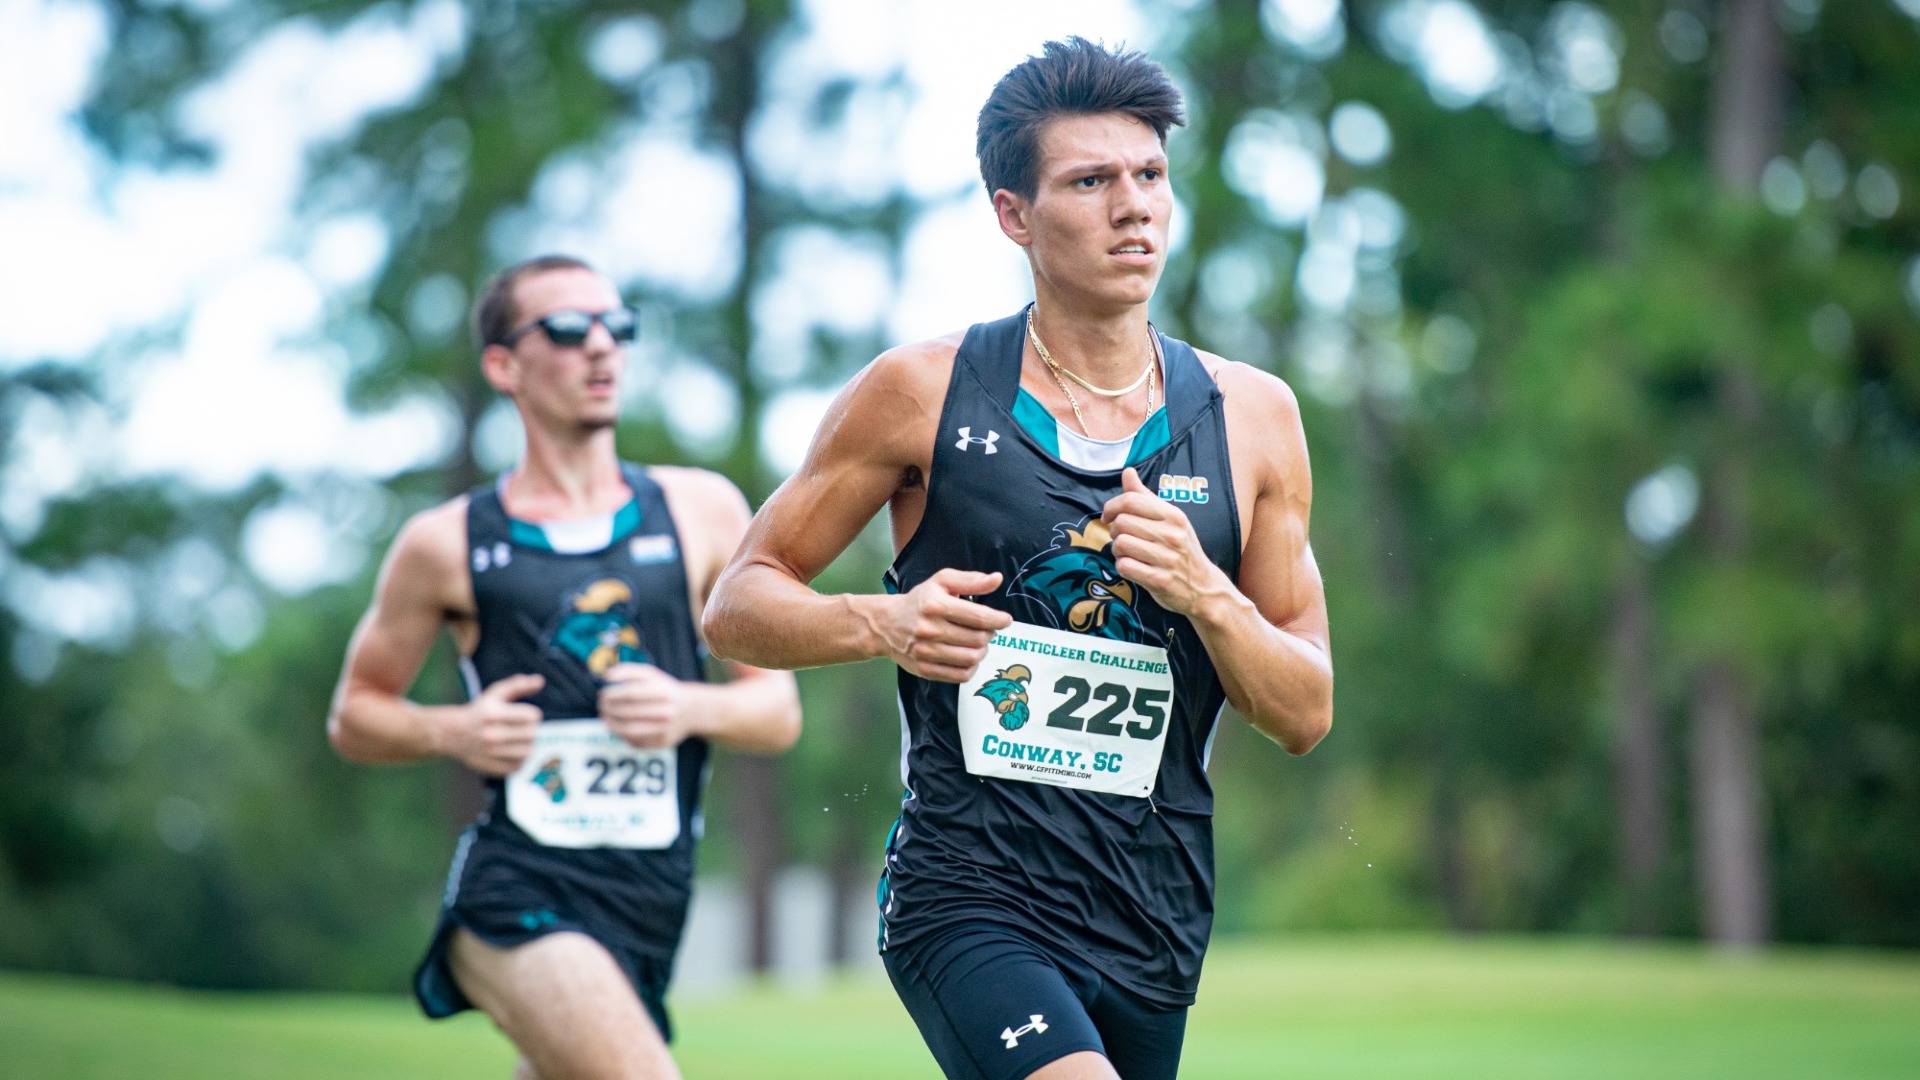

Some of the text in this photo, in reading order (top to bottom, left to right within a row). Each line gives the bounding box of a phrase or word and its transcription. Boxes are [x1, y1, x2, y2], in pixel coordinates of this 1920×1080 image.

[1159, 474, 1209, 504] SBC
[1089, 650, 1168, 674] CHALLENGE
[1046, 675, 1171, 741] 225
[982, 734, 1123, 773] CONWAY, SC
[586, 757, 667, 795] 229
